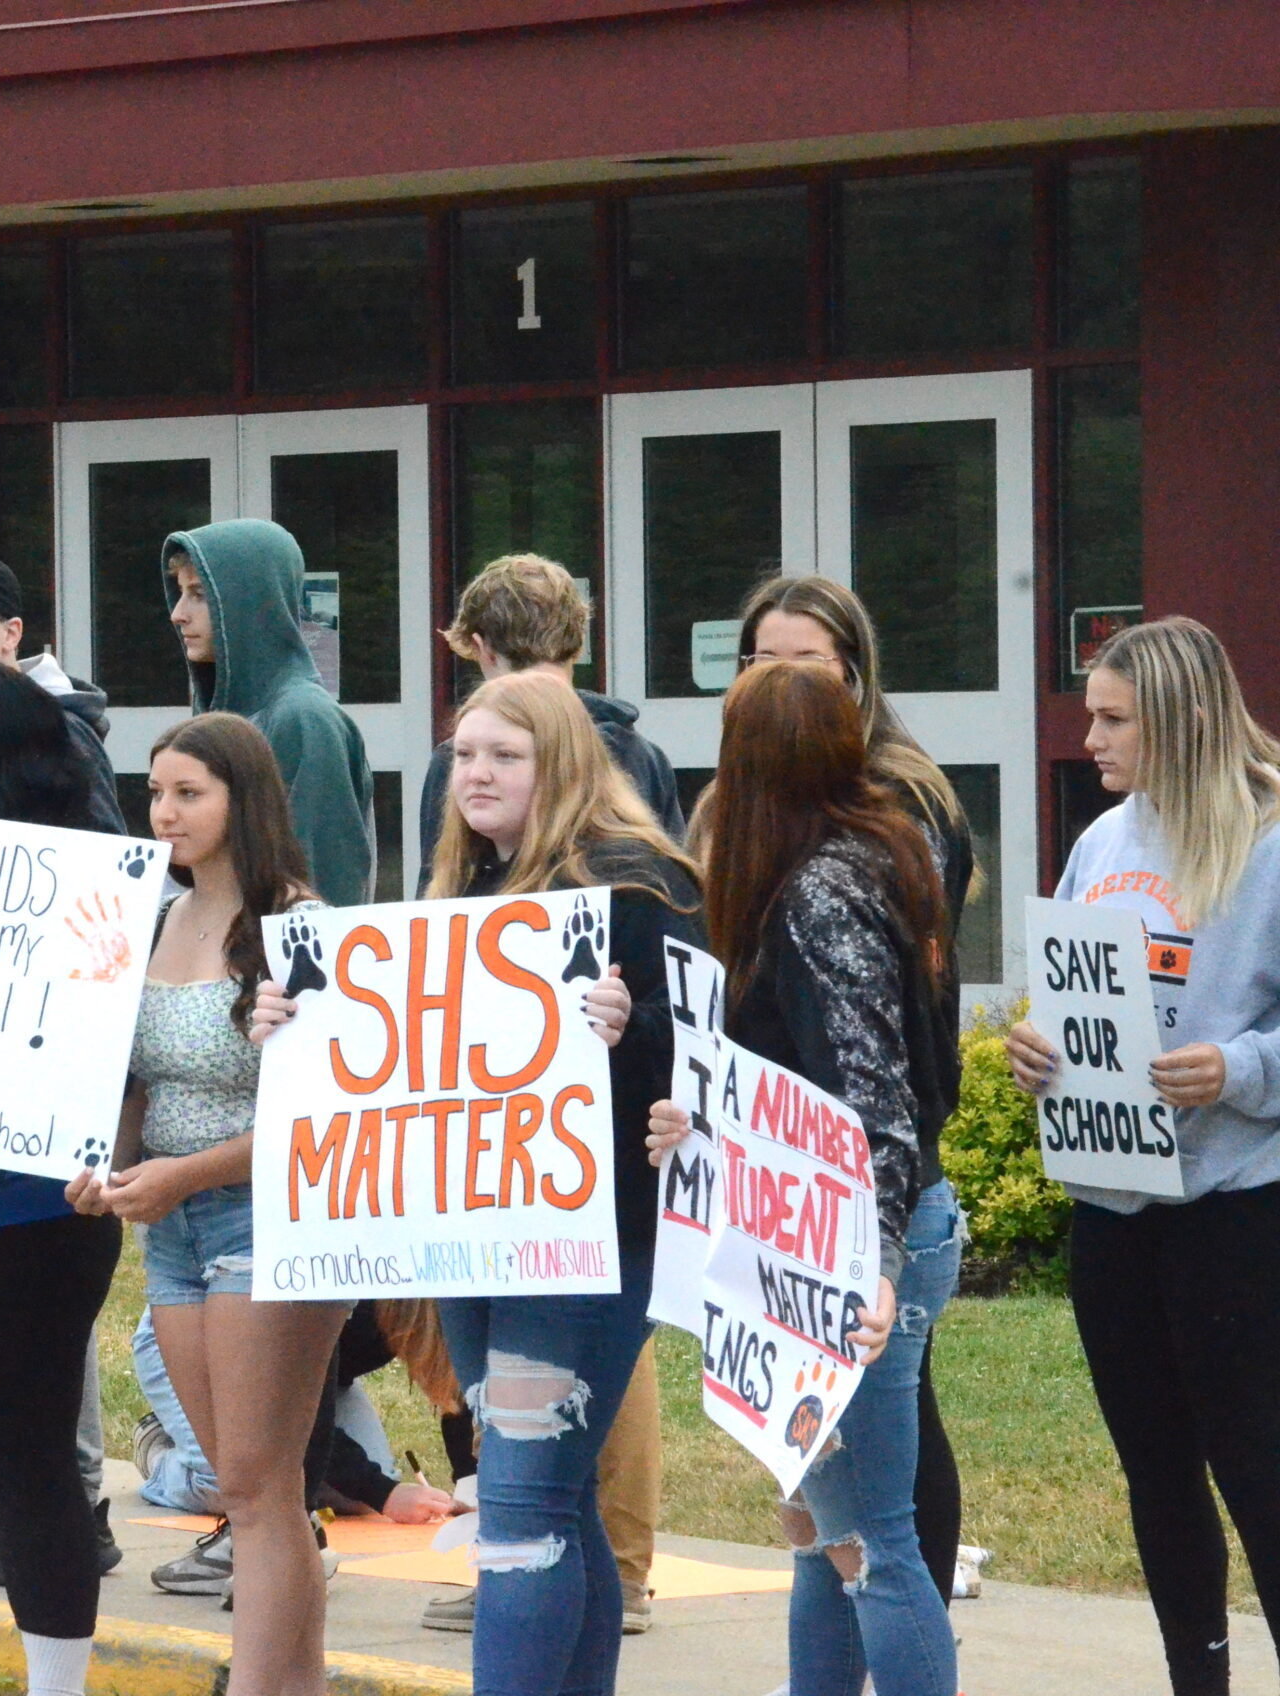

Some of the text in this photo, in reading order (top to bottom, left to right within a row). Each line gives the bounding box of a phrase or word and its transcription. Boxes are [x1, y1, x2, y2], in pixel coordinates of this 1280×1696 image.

[517, 258, 541, 329] 1
[329, 900, 561, 1094] SHS
[1044, 937, 1125, 996] SAVE
[667, 945, 696, 1028] I
[723, 1052, 740, 1122] A
[752, 1066, 873, 1190] NUMBER
[1063, 1016, 1124, 1073] OUR
[688, 1056, 712, 1142] I
[1043, 1096, 1176, 1158] SCHOOLS
[288, 1084, 597, 1222] MATTERS
[665, 1150, 715, 1229] MY
[274, 1256, 306, 1292] as
[310, 1245, 373, 1288] much
[513, 1239, 608, 1280] YOUNGSVILLE
